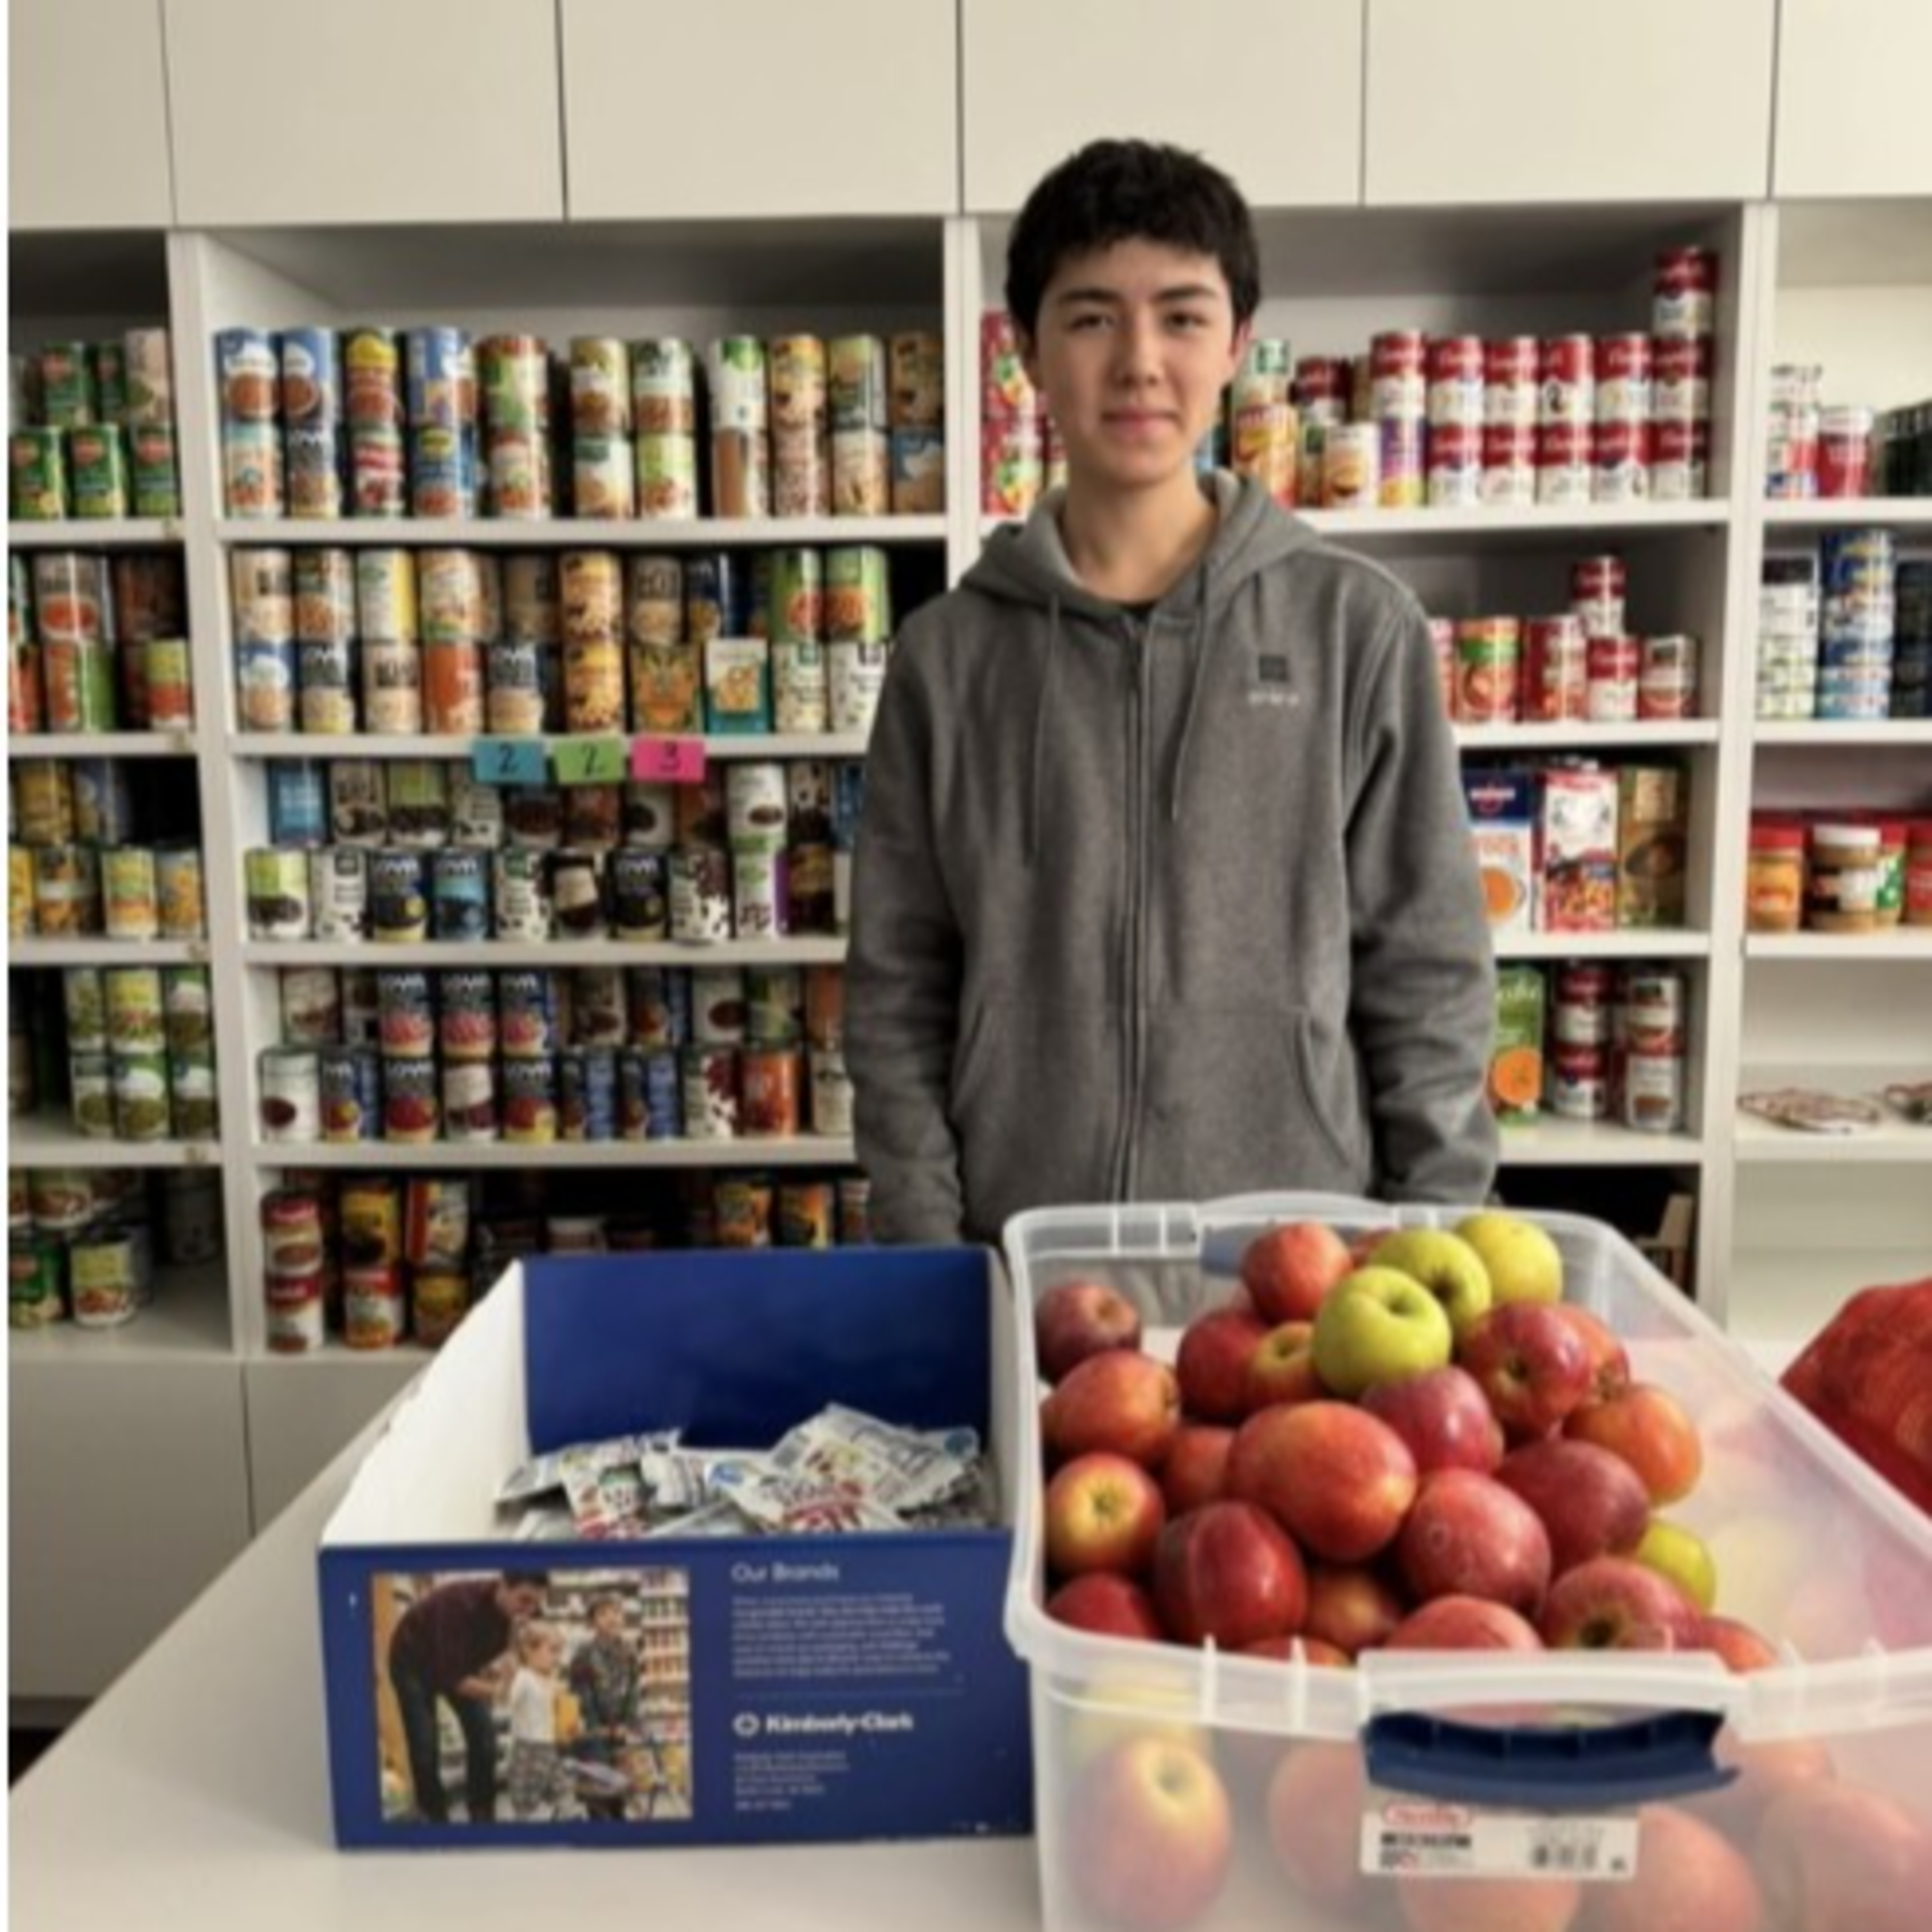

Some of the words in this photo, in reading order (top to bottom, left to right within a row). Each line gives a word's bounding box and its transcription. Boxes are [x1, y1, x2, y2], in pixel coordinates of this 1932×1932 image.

[499, 743, 519, 773] 2
[582, 744, 606, 776] 2
[731, 1561, 766, 1583] Our
[772, 1560, 840, 1582] Brands
